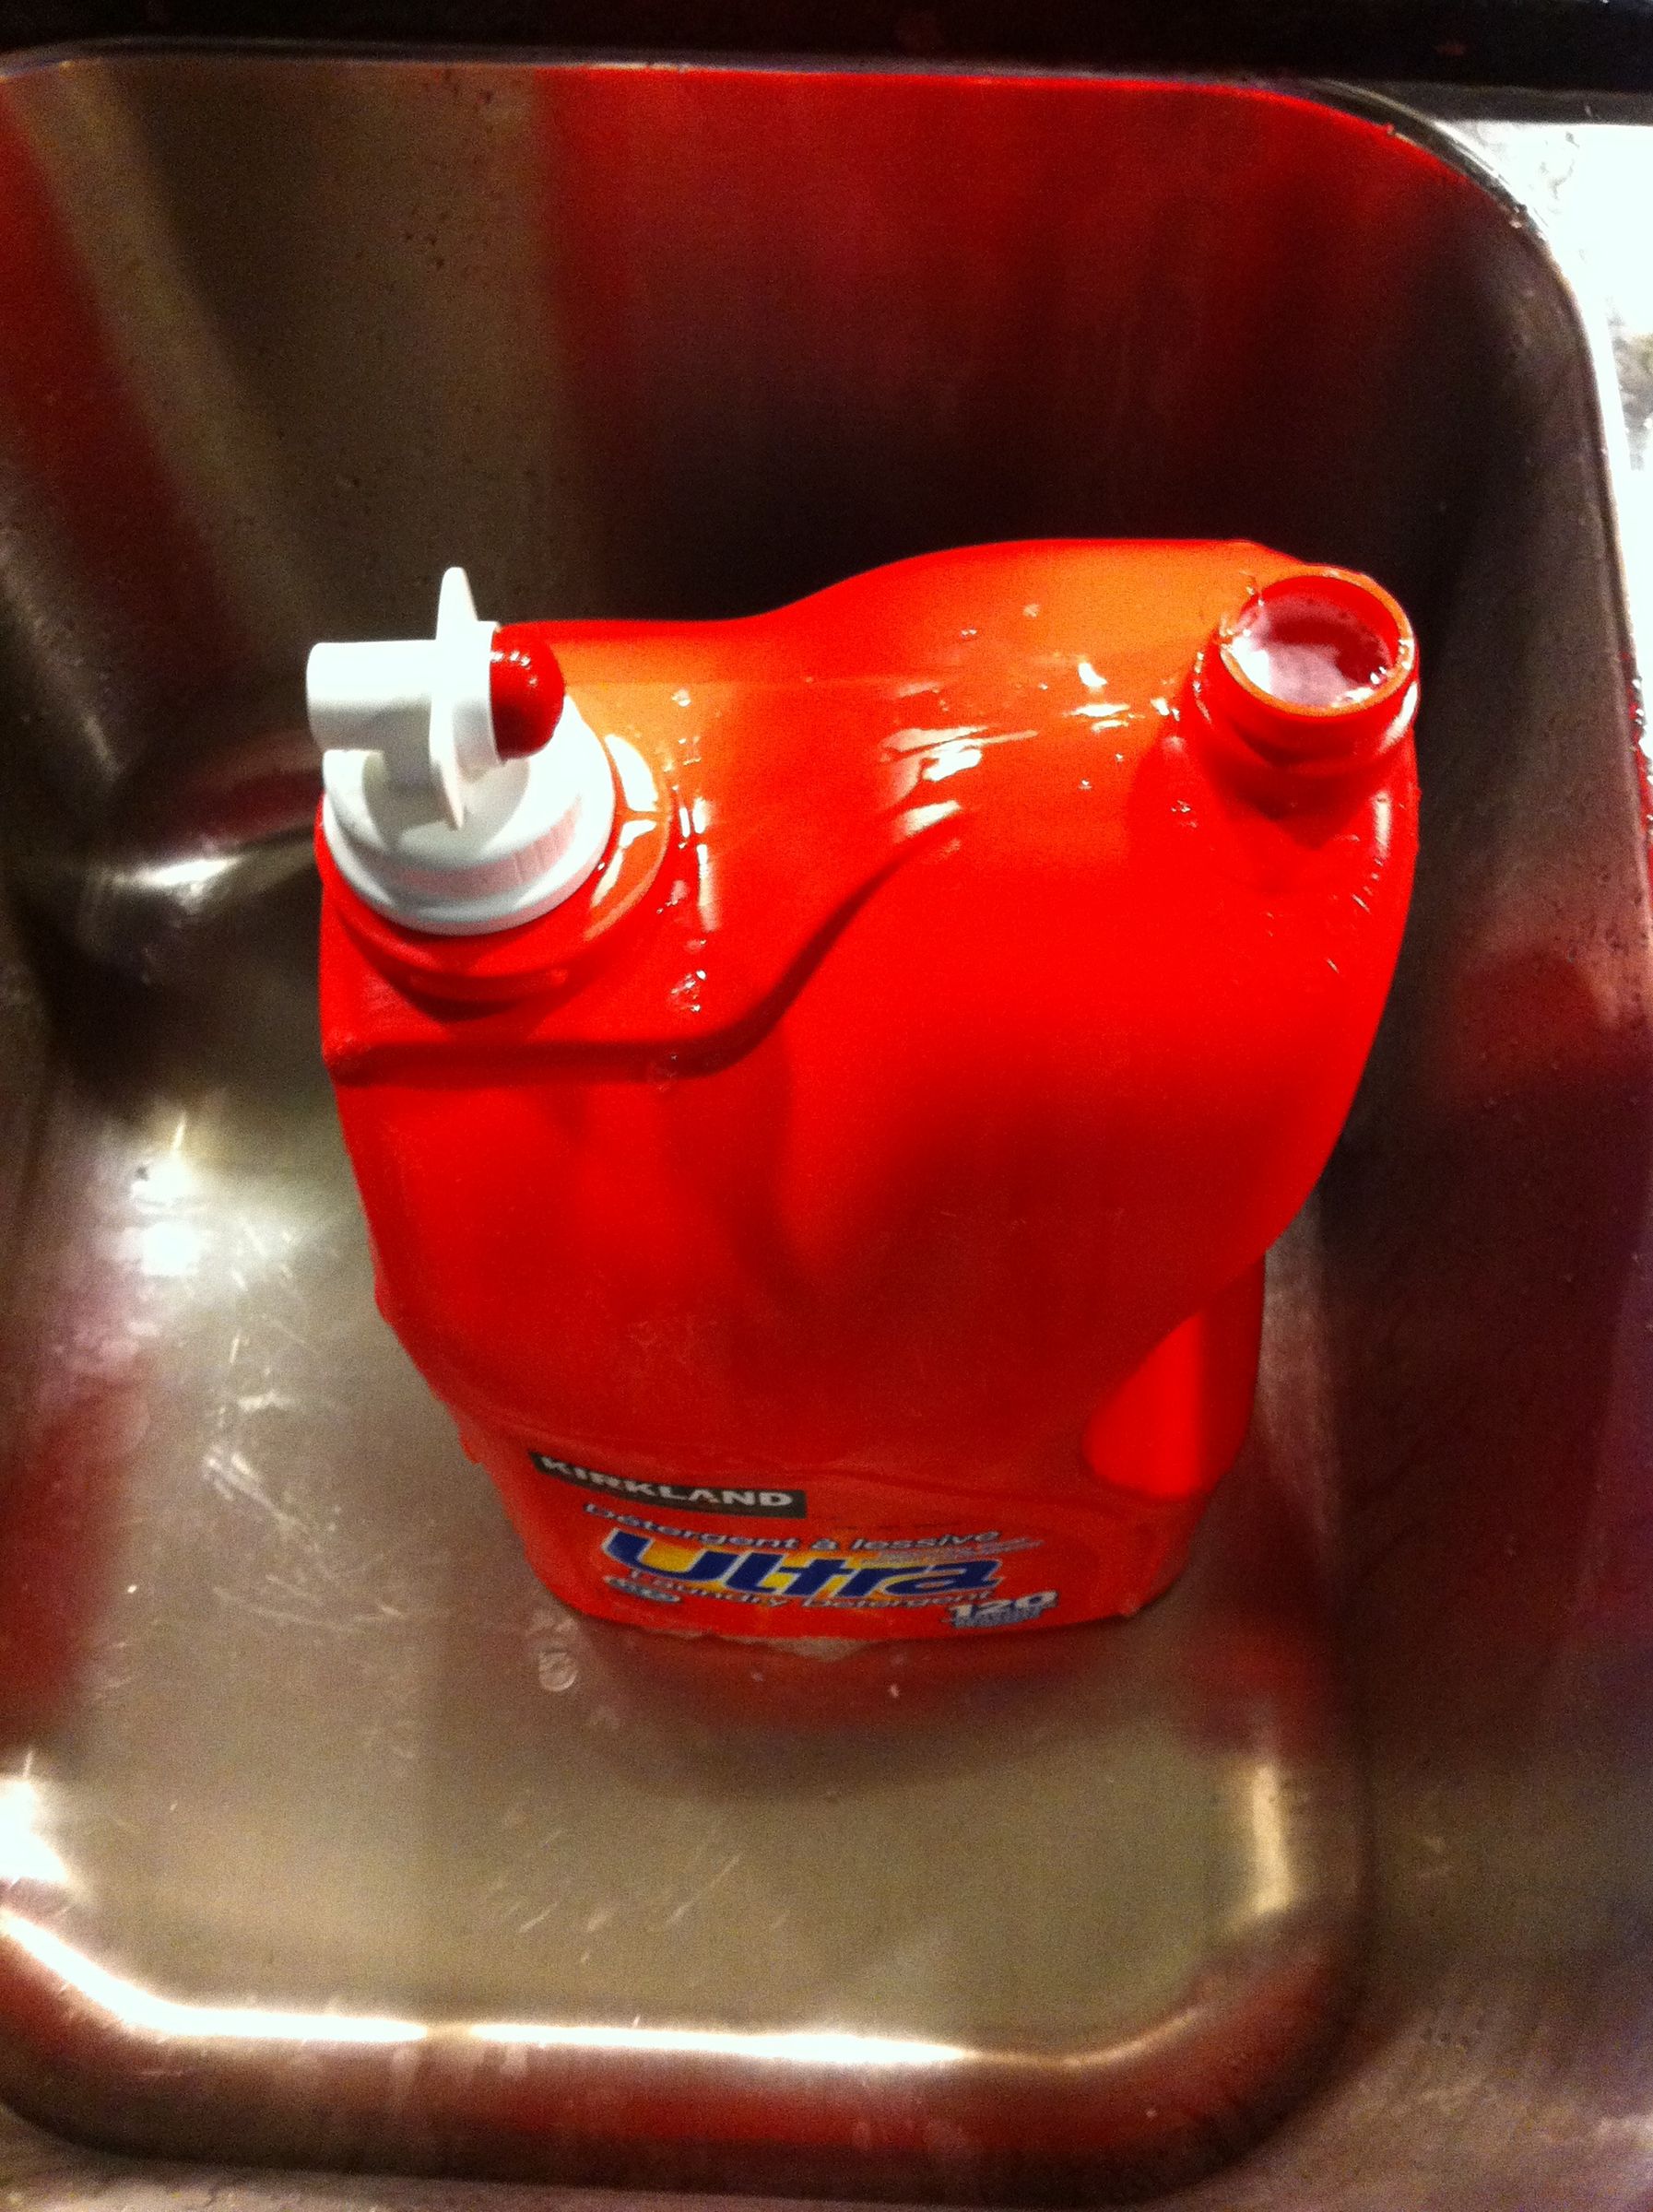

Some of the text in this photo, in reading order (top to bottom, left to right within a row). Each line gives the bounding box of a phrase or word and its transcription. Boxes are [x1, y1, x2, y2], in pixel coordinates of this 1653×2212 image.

[541, 1455, 793, 1507] KIRKLAND
[601, 1527, 1005, 1599] Ultra
[948, 1590, 1059, 1618] 120
